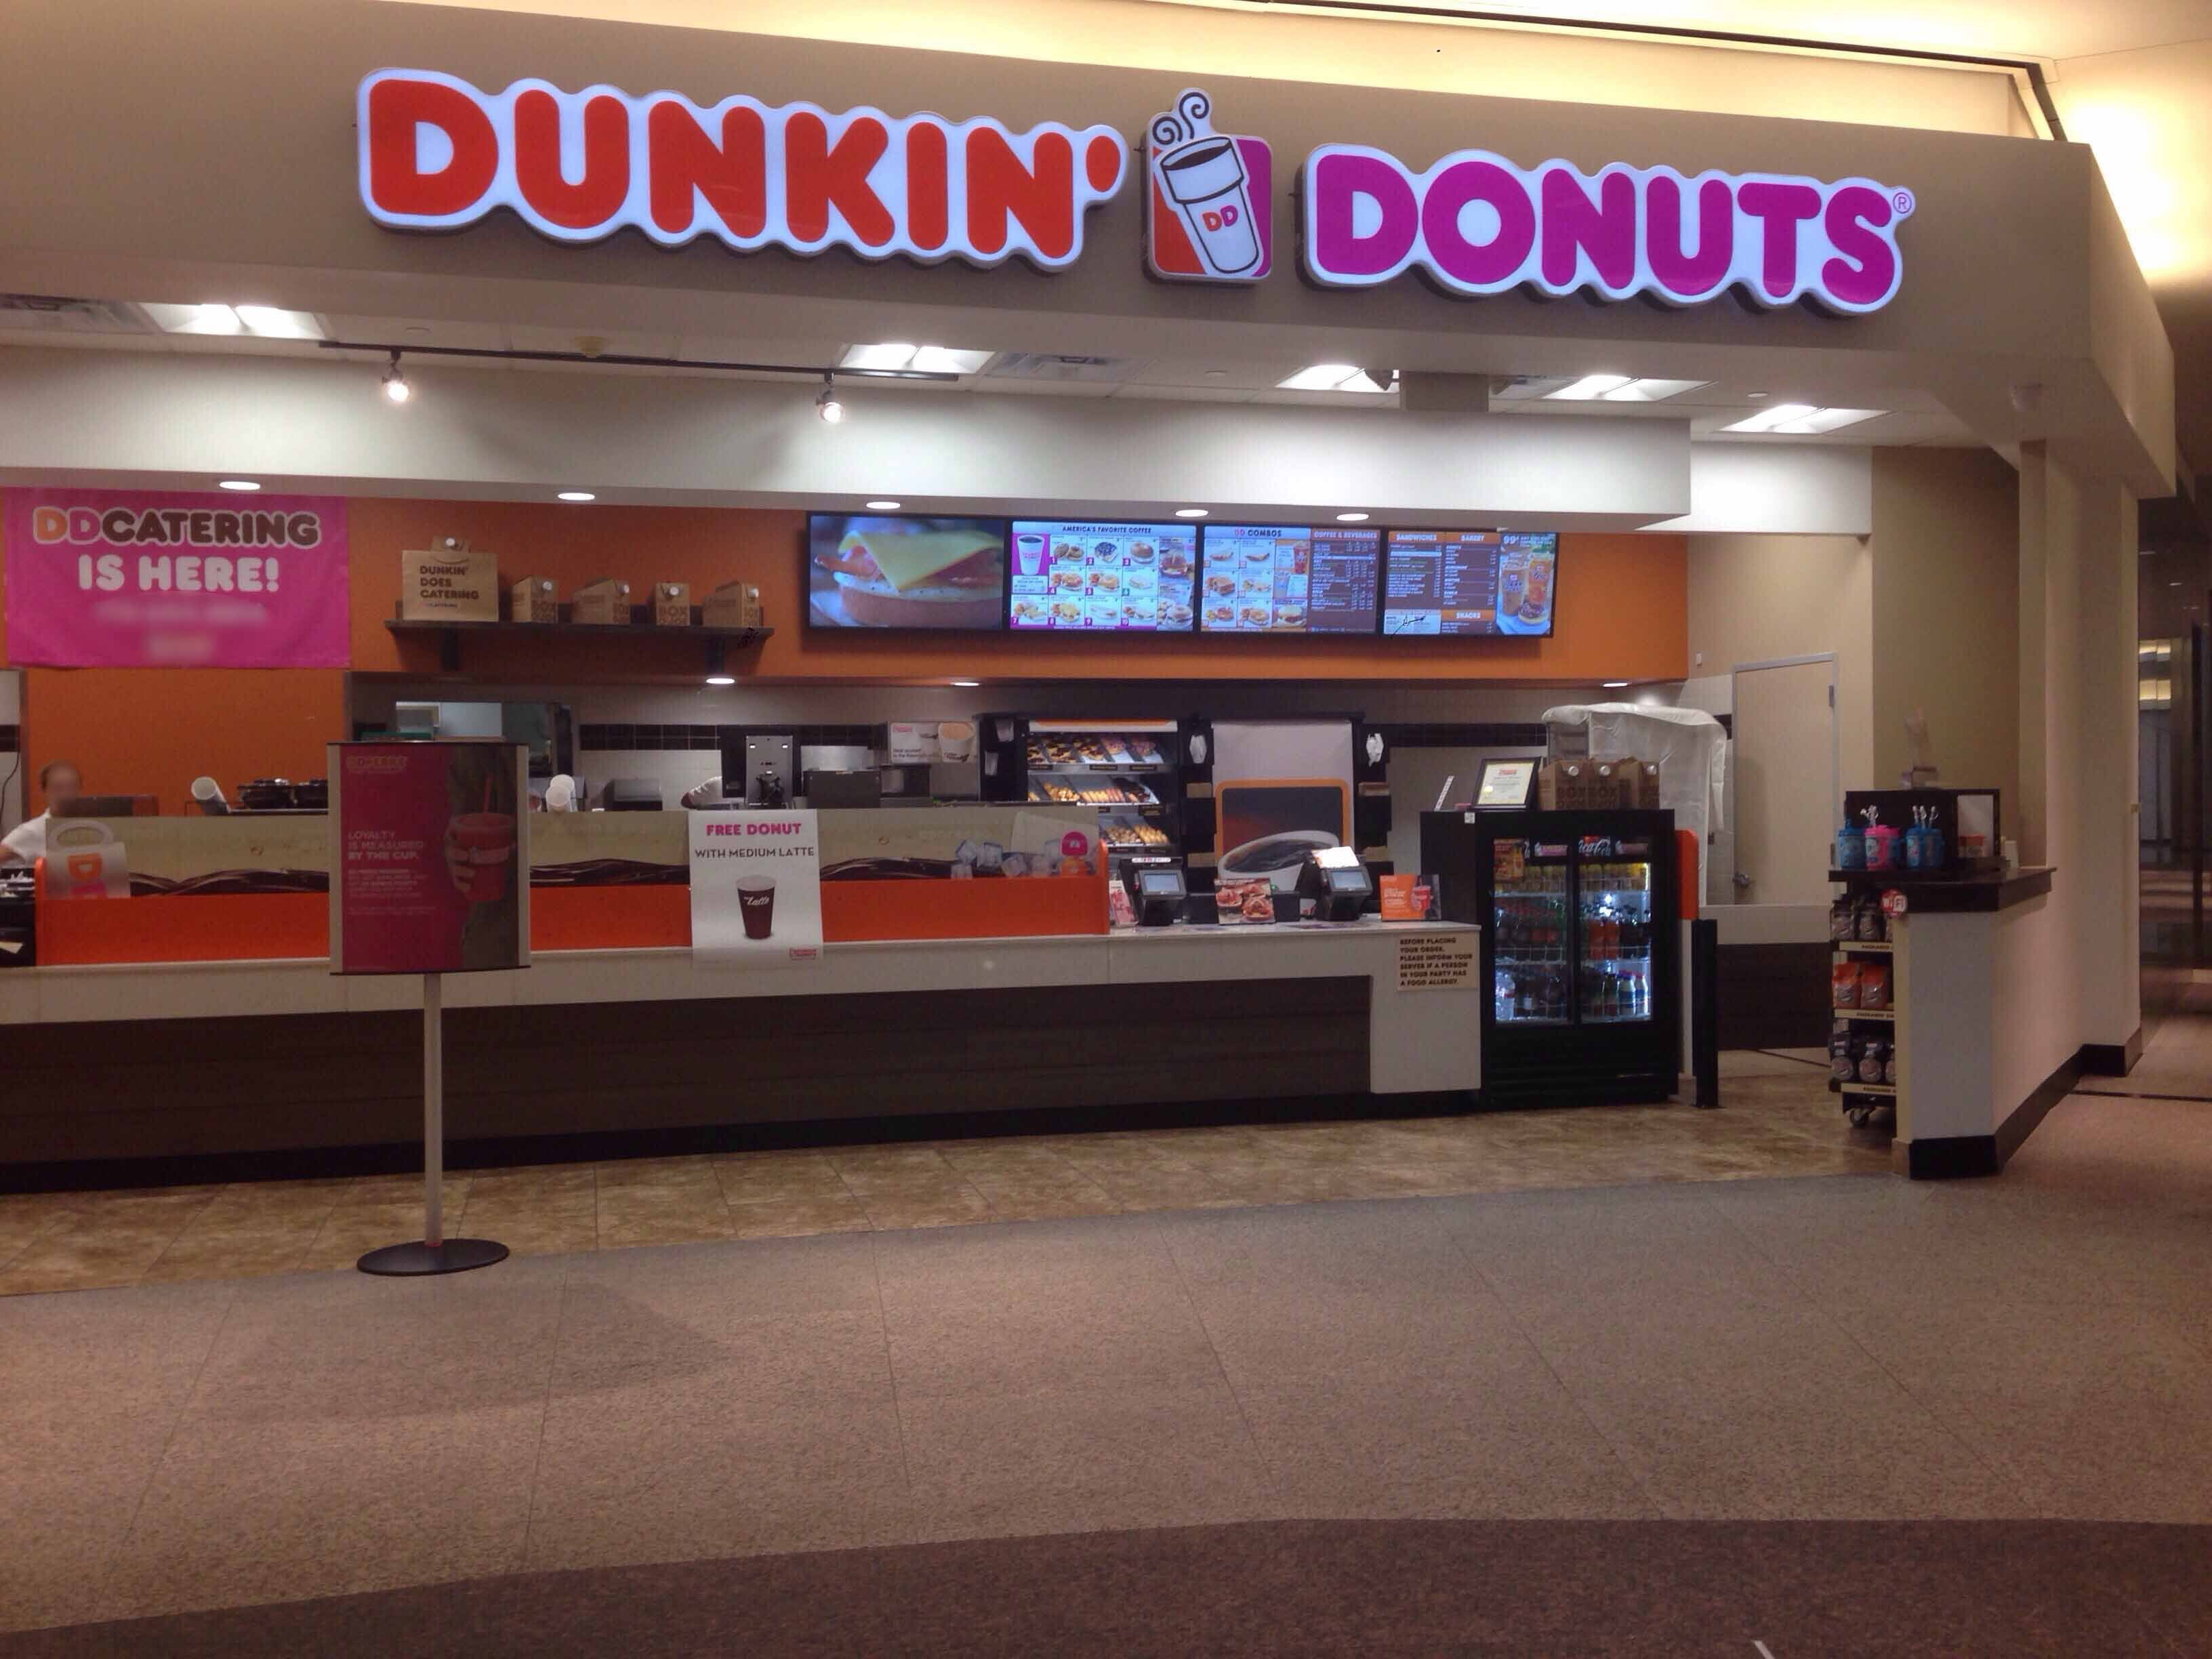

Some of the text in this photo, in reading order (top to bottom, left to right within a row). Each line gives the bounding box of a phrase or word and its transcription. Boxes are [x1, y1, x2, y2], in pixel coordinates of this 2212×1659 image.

[369, 78, 1121, 260] DUNKIN'
[1201, 205, 1240, 232] DD
[79, 554, 280, 592] IS HERE!
[419, 565, 468, 575] DUNKIN'
[419, 578, 453, 588] DOES
[419, 590, 480, 600] CATERING
[706, 823, 802, 836] FREE DONUT
[695, 847, 814, 858] WITH MEDIUM LATTE
